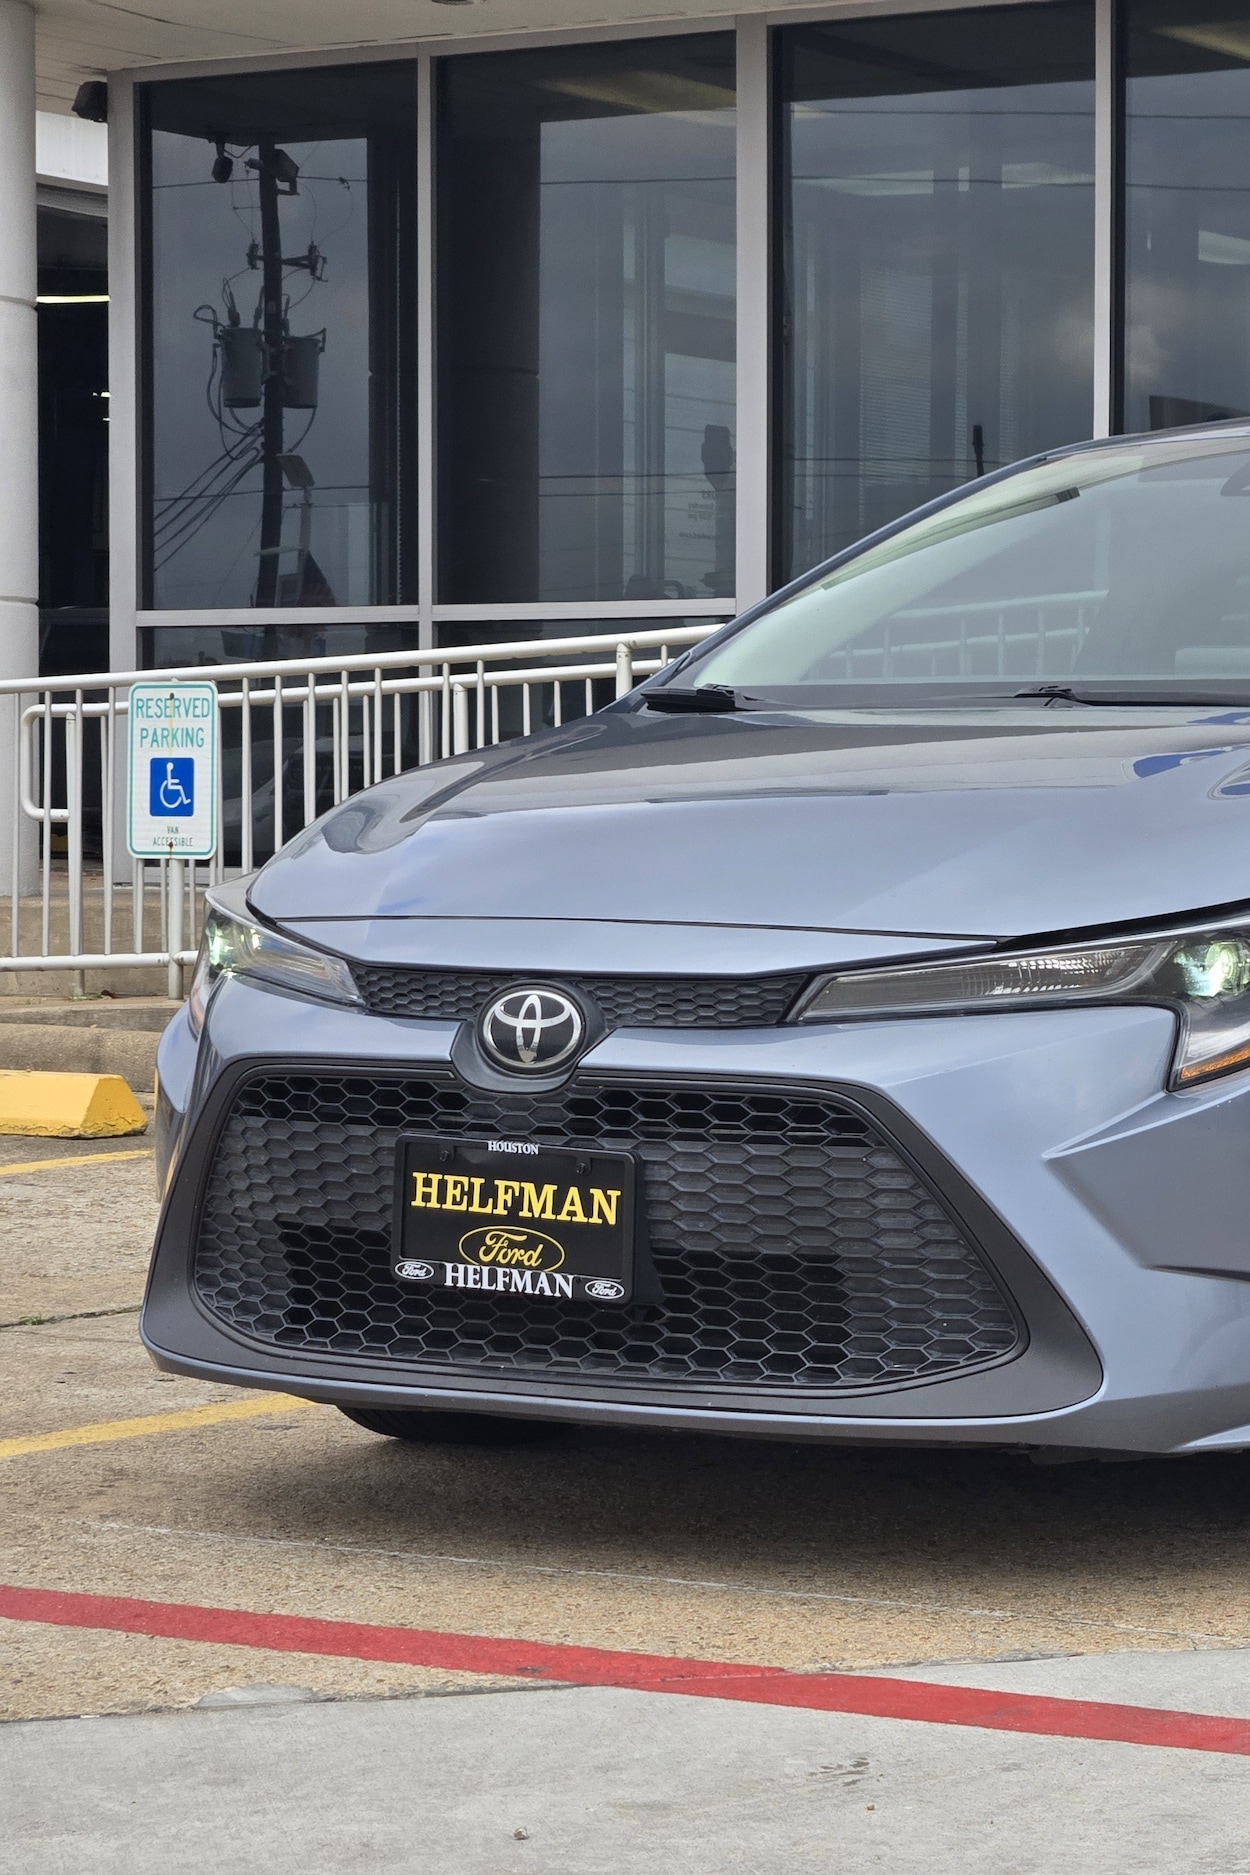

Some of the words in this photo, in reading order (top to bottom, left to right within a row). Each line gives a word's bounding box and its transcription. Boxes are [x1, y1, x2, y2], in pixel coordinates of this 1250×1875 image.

[136, 698, 210, 718] RESERVED
[140, 728, 204, 748] PARKING
[167, 825, 179, 834] VAN
[153, 837, 193, 847] ACCESSIBLE
[487, 1140, 539, 1155] HOUSTON
[410, 1171, 622, 1226] HELFMAN
[478, 1230, 544, 1268] Ford
[401, 1262, 428, 1277] Ford
[444, 1262, 575, 1299] HELFMAN
[591, 1281, 618, 1297] Ford
